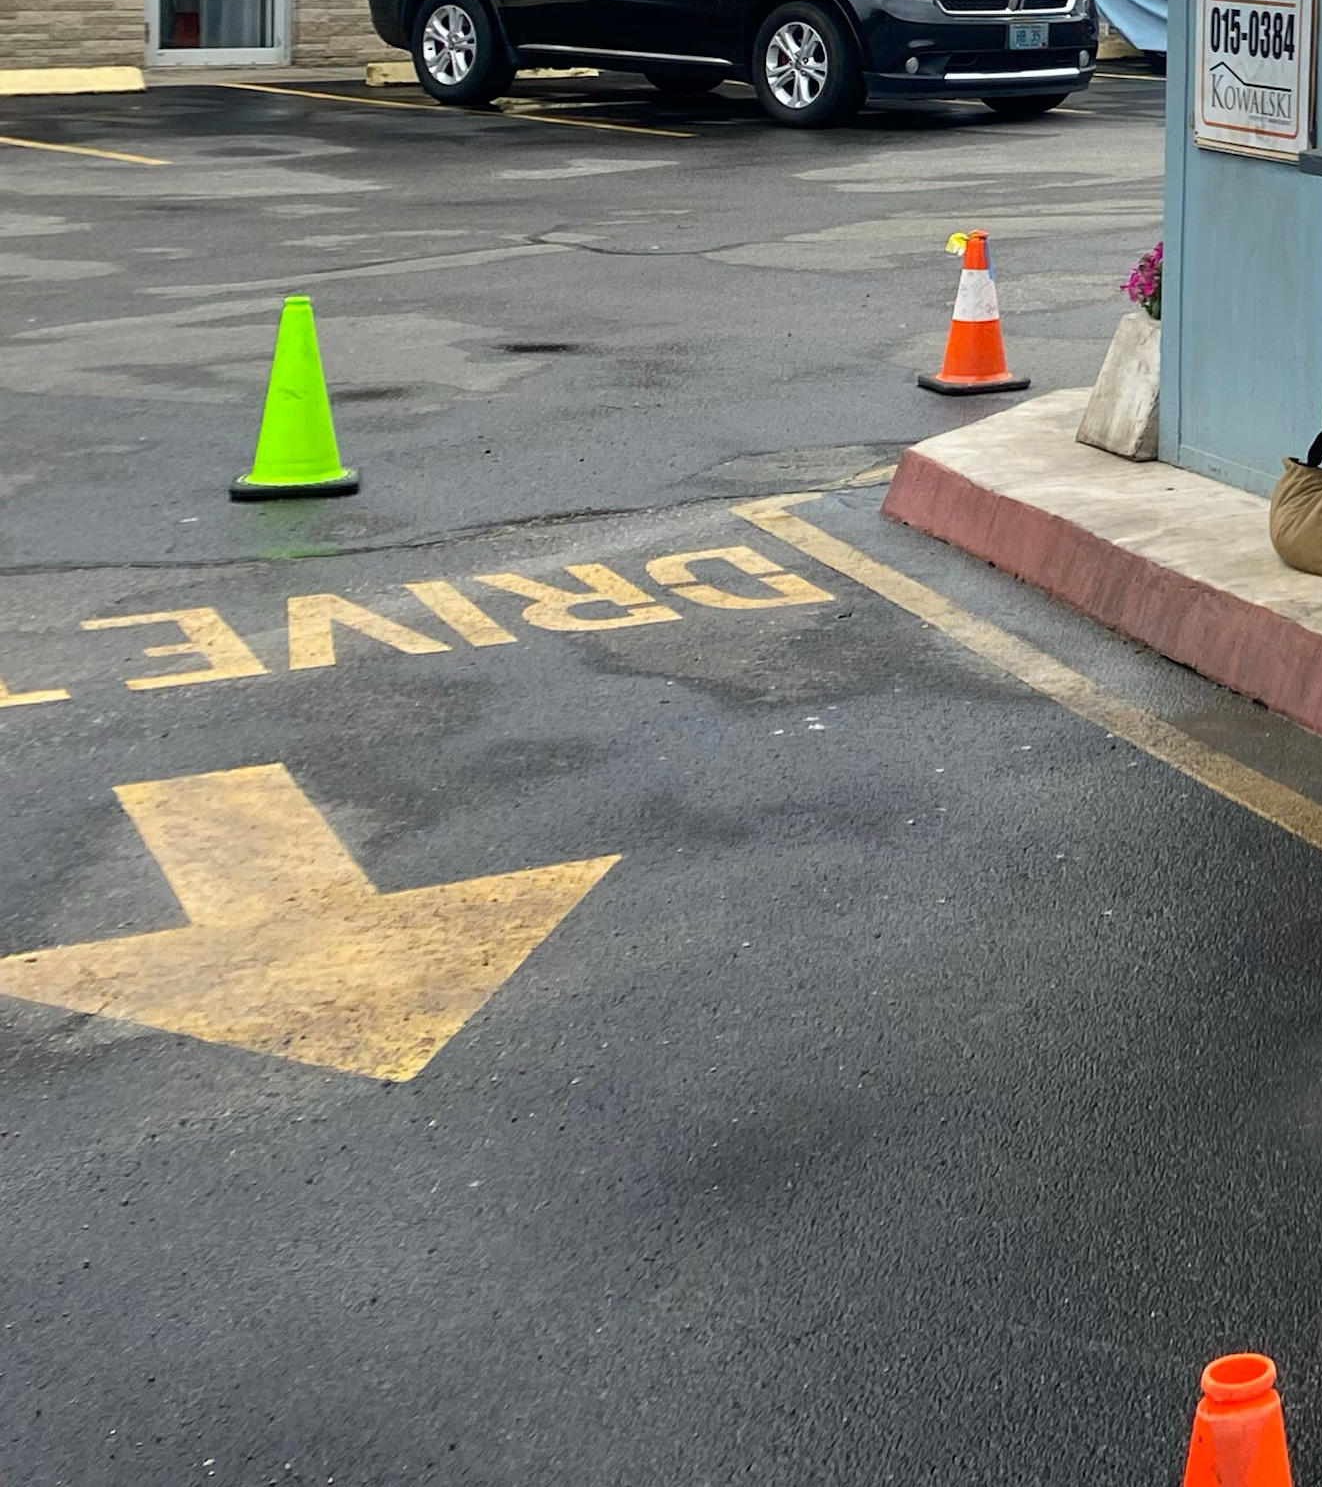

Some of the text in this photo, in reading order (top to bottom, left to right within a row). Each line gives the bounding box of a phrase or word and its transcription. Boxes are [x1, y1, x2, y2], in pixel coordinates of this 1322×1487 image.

[1210, 7, 1296, 61] 015-0384
[1210, 73, 1293, 119] KOWALSKI
[80, 544, 837, 691] DRIVE
